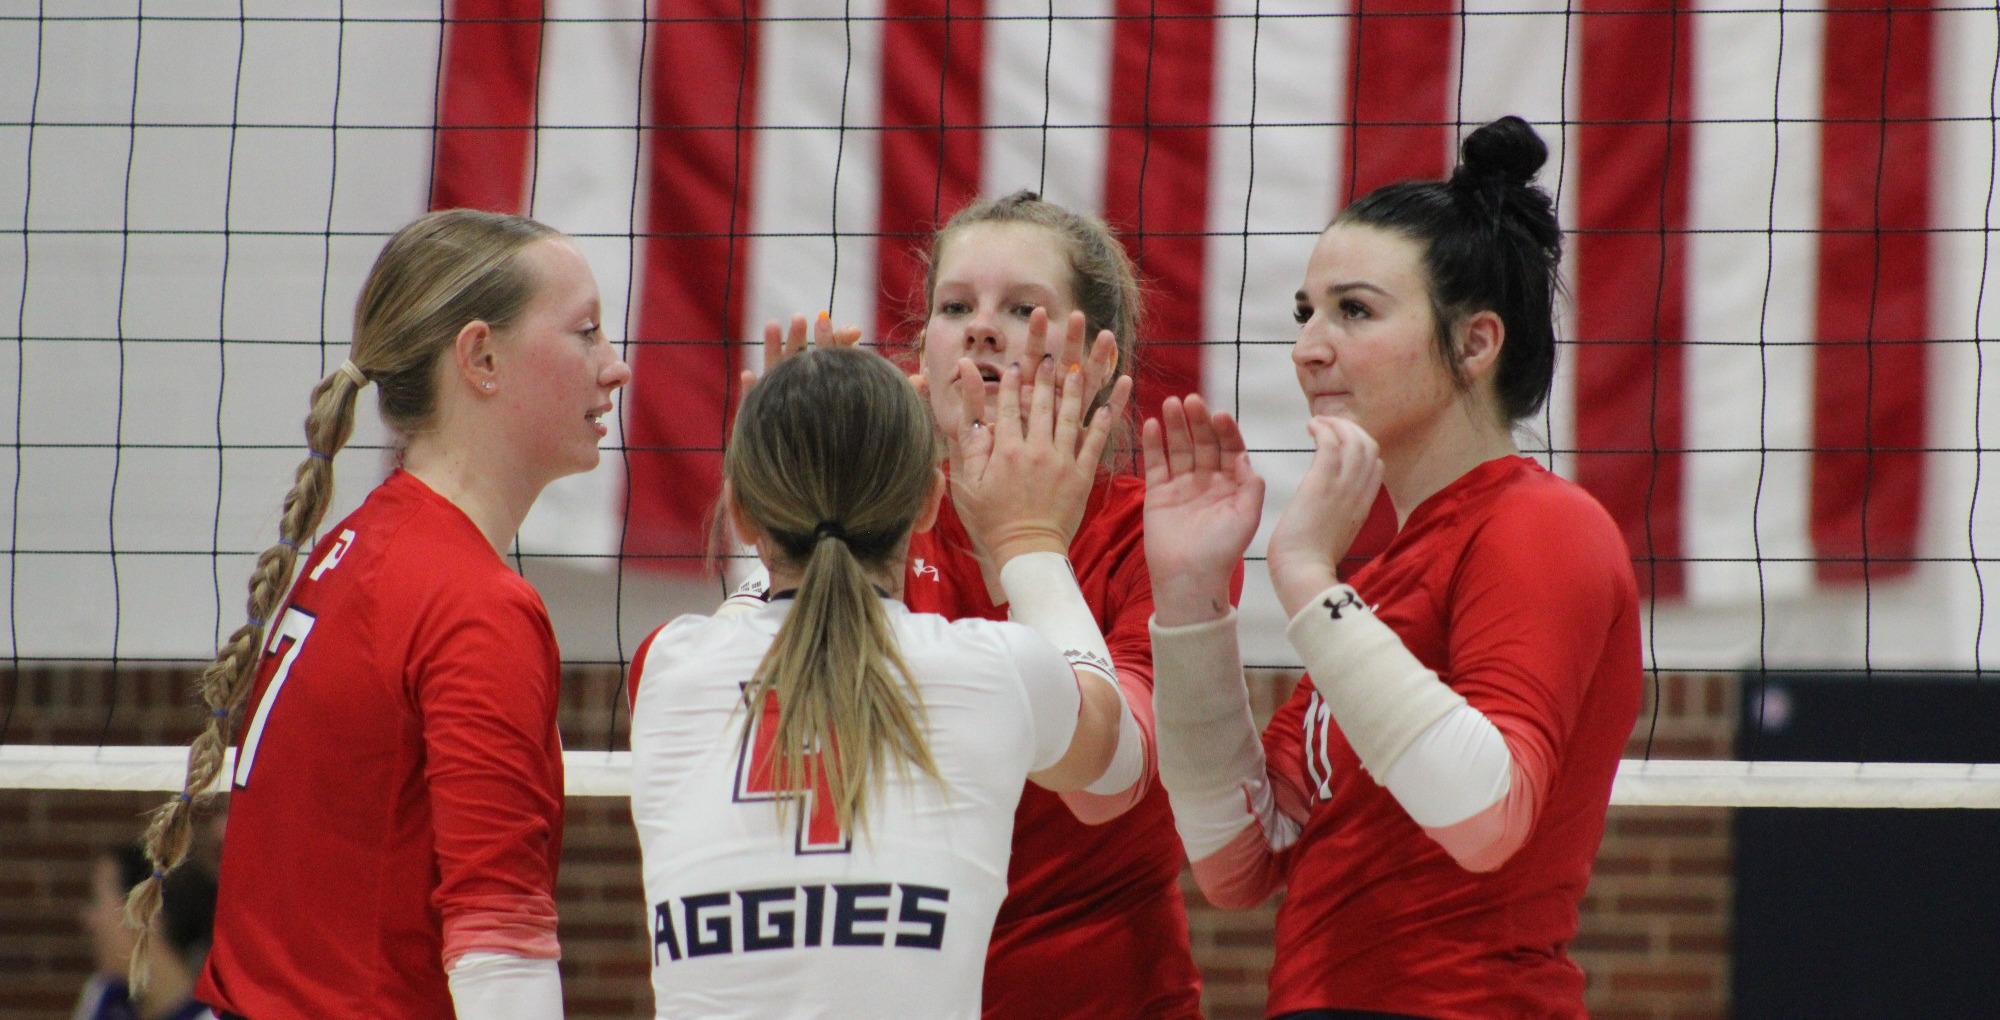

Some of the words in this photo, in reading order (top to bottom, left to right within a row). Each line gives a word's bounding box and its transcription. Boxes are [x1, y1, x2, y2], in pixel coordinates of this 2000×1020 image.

[235, 602, 318, 790] 7
[1303, 690, 1333, 801] 11
[732, 681, 855, 856] 4
[655, 883, 950, 966] AGGIES
